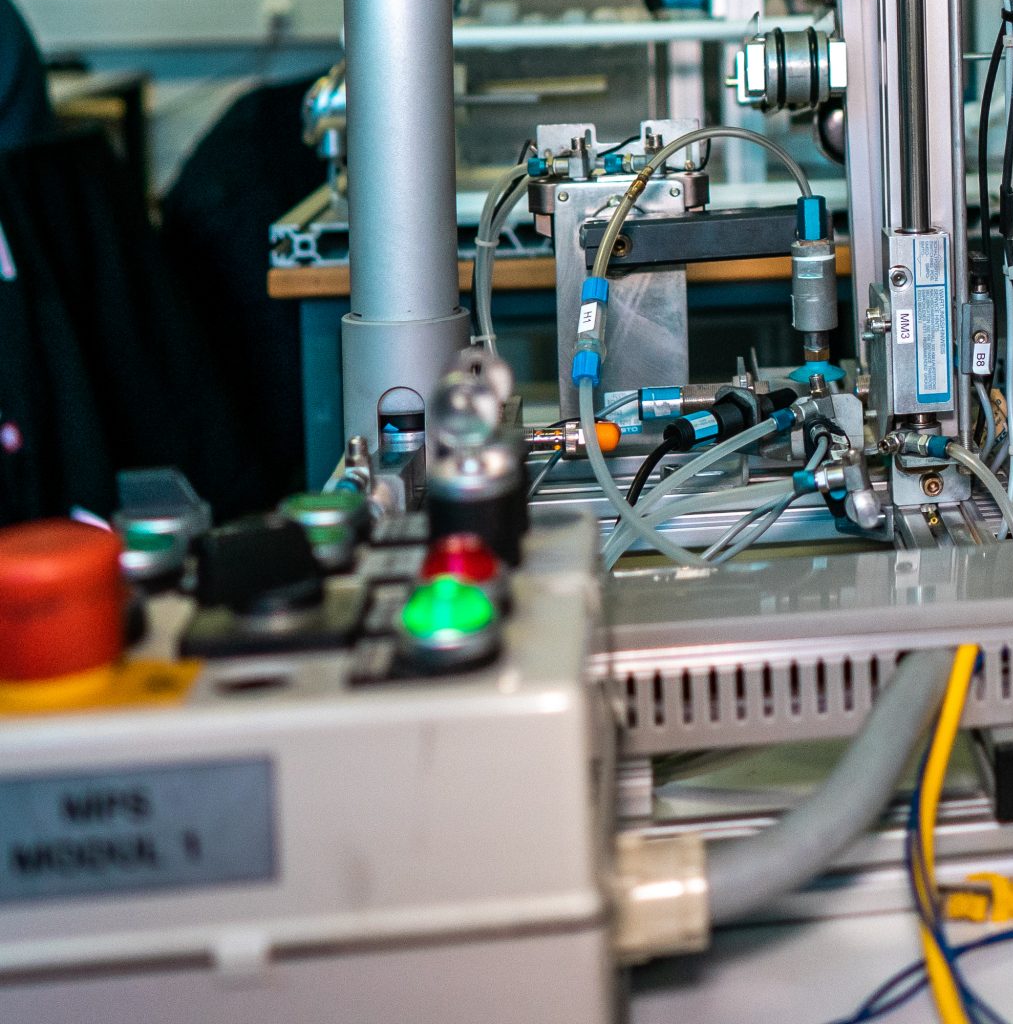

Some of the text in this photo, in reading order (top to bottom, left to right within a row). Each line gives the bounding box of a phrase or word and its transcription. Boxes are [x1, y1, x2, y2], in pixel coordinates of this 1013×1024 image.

[584, 311, 592, 324] H1
[900, 313, 910, 339] MM3
[976, 352, 986, 367] B8
